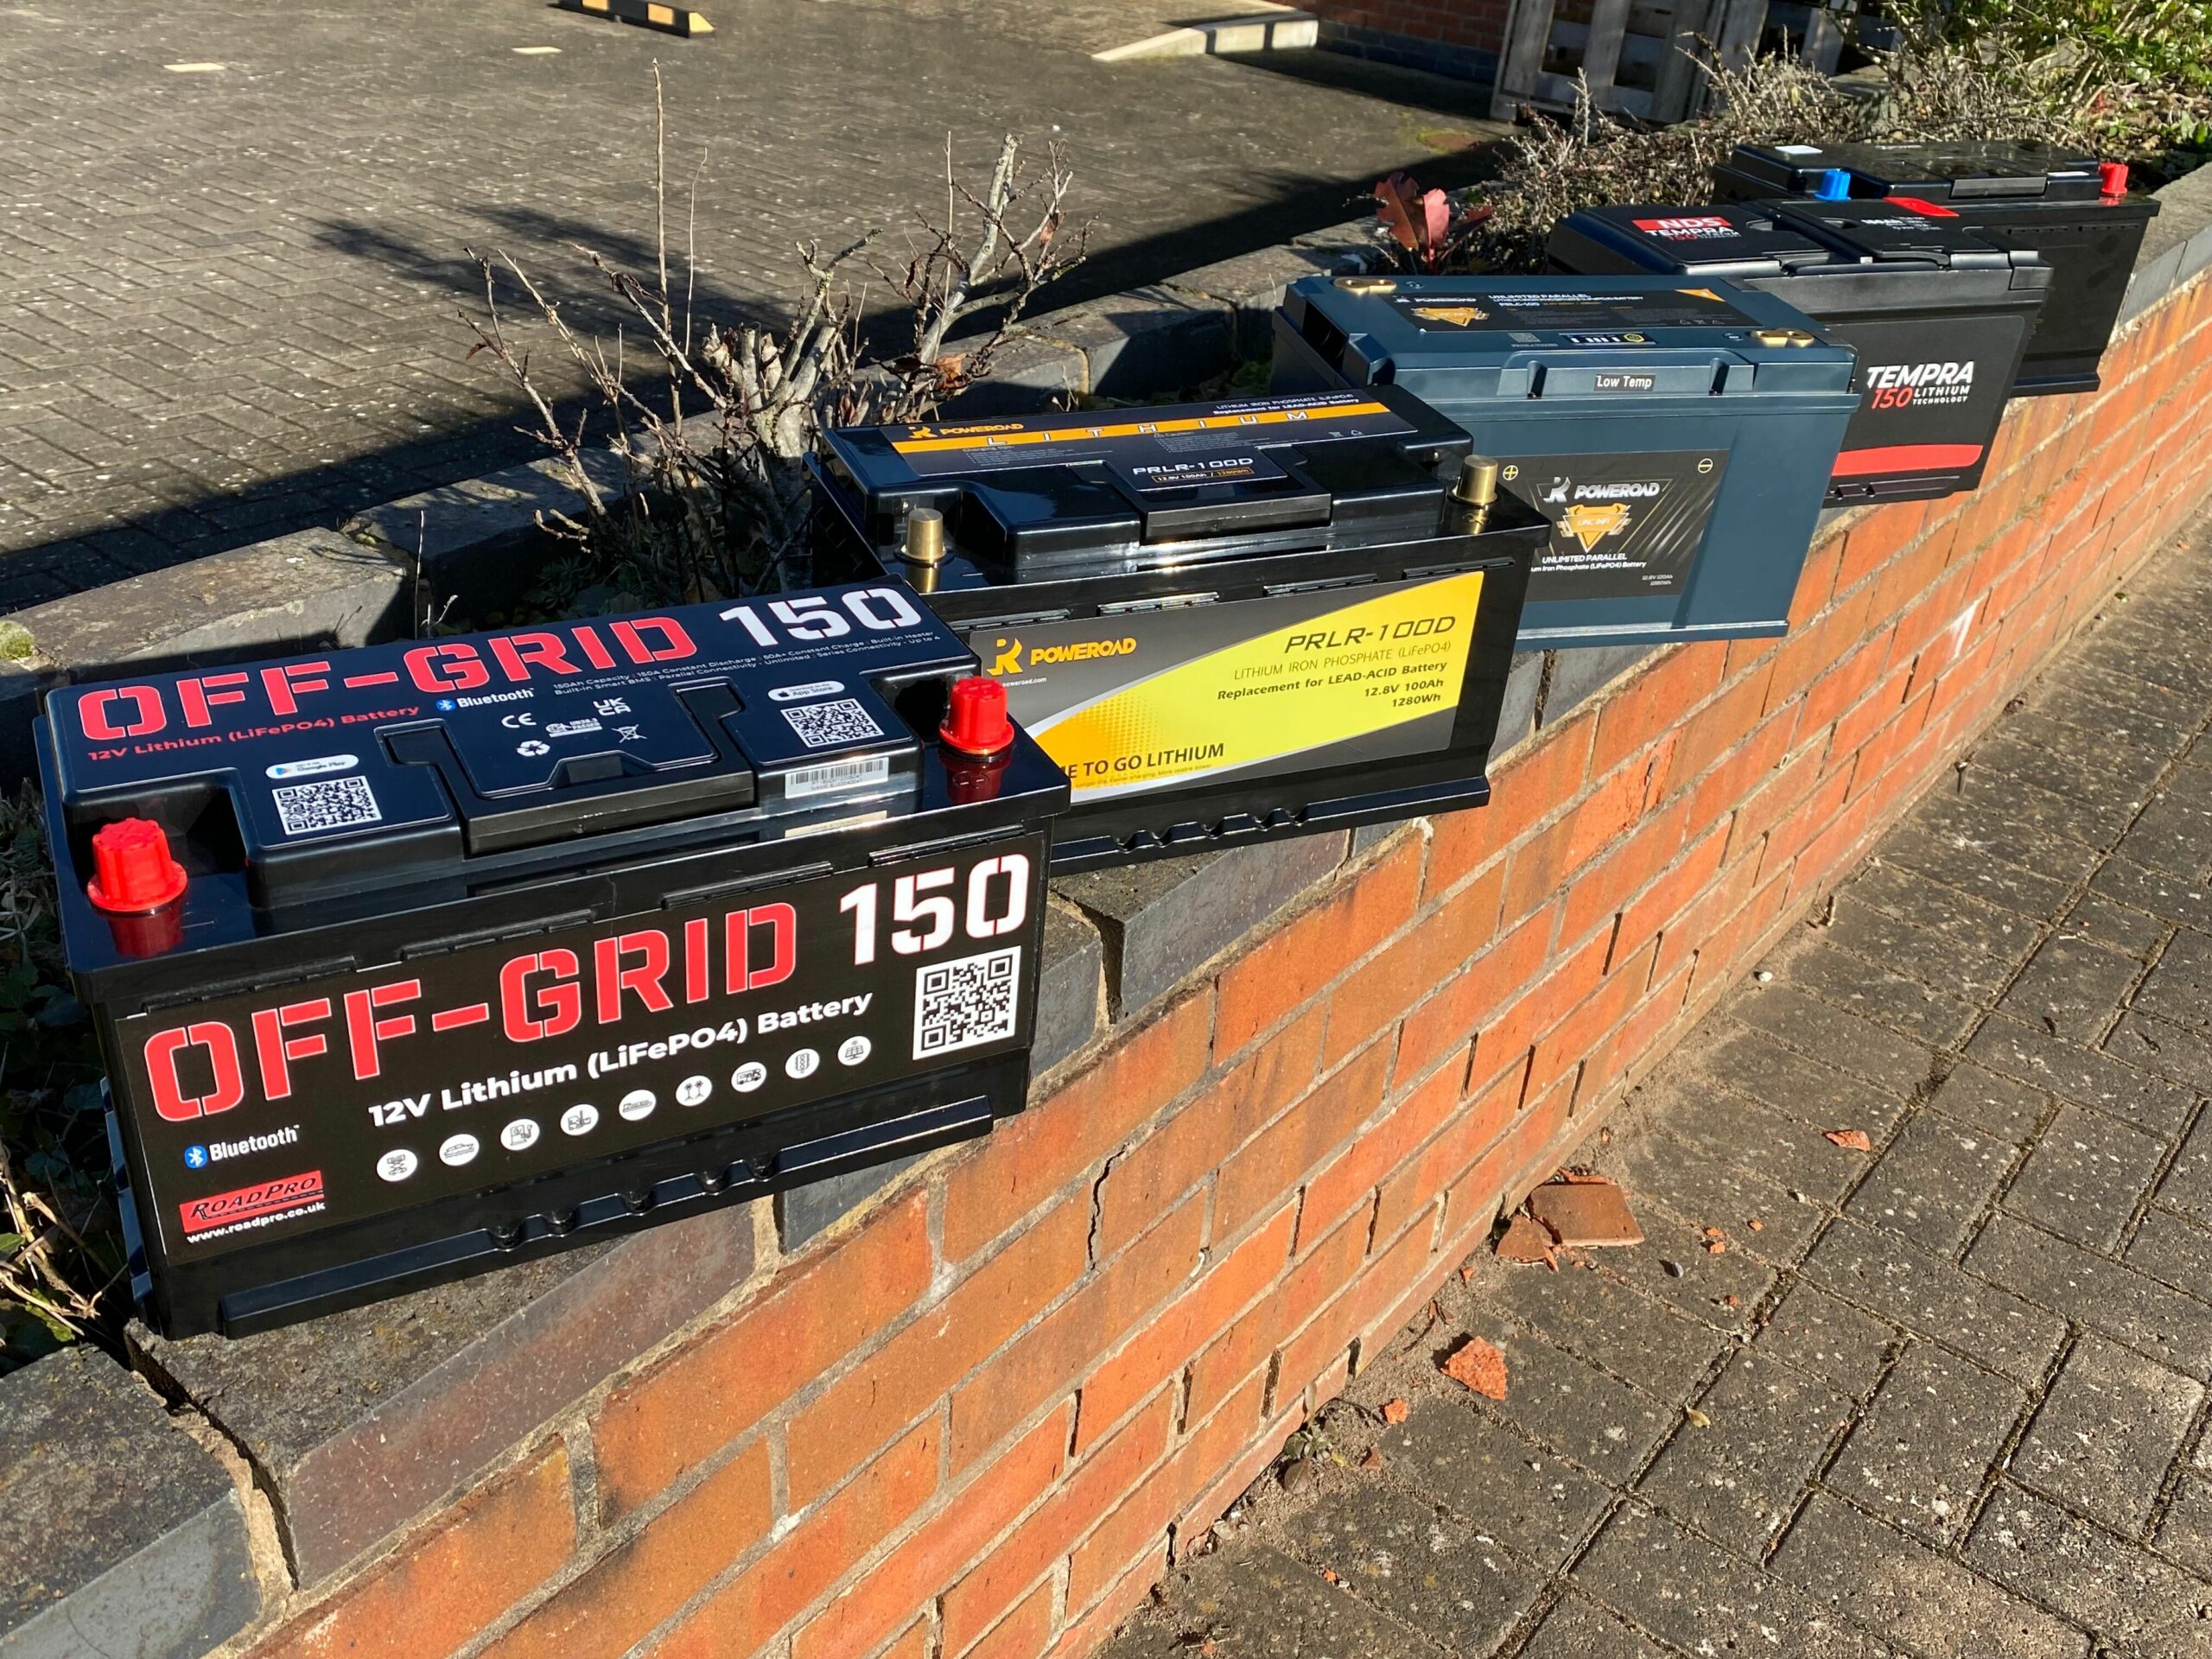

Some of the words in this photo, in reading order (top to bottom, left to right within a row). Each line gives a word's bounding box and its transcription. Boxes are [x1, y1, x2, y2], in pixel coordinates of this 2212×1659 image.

[1644, 226, 1734, 237] TEMPRA
[1658, 218, 1722, 229] NDS
[1597, 375, 1622, 388] Low
[1623, 375, 1654, 391] Temp
[1867, 361, 1975, 389] TEMPRA
[1872, 387, 1913, 410] 150
[1913, 385, 1971, 398] LITHIUM
[1912, 395, 1968, 405] TECHNOLOGY
[938, 423, 1025, 436] POWEROAD
[987, 410, 1309, 445] LITHIUM
[1132, 457, 1255, 476] PRLR-100D
[1573, 481, 1661, 500] POWEROAD
[1541, 555, 1586, 565] UNLIMITED
[1586, 552, 1628, 563] PARALLEL
[1284, 614, 1457, 654] PRLR-100D
[77, 615, 698, 741] OFF-GRID
[718, 588, 923, 648] 150
[553, 678, 585, 690] 150Ah
[586, 673, 631, 687] Capacity
[636, 670, 660, 680] 150A
[661, 663, 707, 675] Constant
[709, 656, 757, 670] Discharge
[787, 645, 831, 658] Constant
[830, 640, 866, 652] Charge
[869, 634, 904, 645] Built-in
[904, 631, 935, 641] Heater
[554, 684, 594, 696] Built-in
[594, 678, 627, 690] Smart
[628, 676, 653, 686] BMS
[658, 669, 696, 681] Parallel
[696, 660, 757, 675] Connectivity
[764, 653, 812, 666] Unlimited
[816, 648, 845, 658] Series
[846, 641, 902, 654] Connectivity
[907, 637, 922, 645] Up
[1030, 636, 1137, 667] POWEROAD
[1234, 664, 1283, 681] LITHIUM
[1288, 658, 1319, 674] IRON
[1323, 648, 1394, 670] PHOSPHATE
[1397, 639, 1452, 659] (LiFePO4)
[1217, 679, 1301, 702] Replacement
[1305, 677, 1324, 689] for
[1327, 666, 1398, 686] LEAD-ACID
[1401, 660, 1448, 676] Battery
[1363, 683, 1401, 698] 12.8V
[1404, 677, 1445, 693] 100Ah
[455, 690, 534, 710] Bluetooth
[1391, 692, 1442, 709] 1280Wh
[87, 746, 129, 762] 12V
[133, 733, 224, 757] Lithium
[226, 714, 336, 744] (LiFePO4)
[340, 705, 421, 726] Battery
[1083, 759, 1109, 777] TO
[1114, 753, 1142, 772] GO
[1147, 742, 1225, 768] LITHIUM
[143, 902, 797, 1122] OFF-GRID
[838, 852, 1031, 967] 150
[367, 1092, 432, 1128] 12V
[440, 1062, 579, 1111] Lithium
[587, 1017, 749, 1080] (LiFePO4)
[757, 991, 874, 1035] Battery
[208, 1126, 299, 1162] Bluetooth
[185, 1201, 327, 1244] www.roadpro.co.uk
